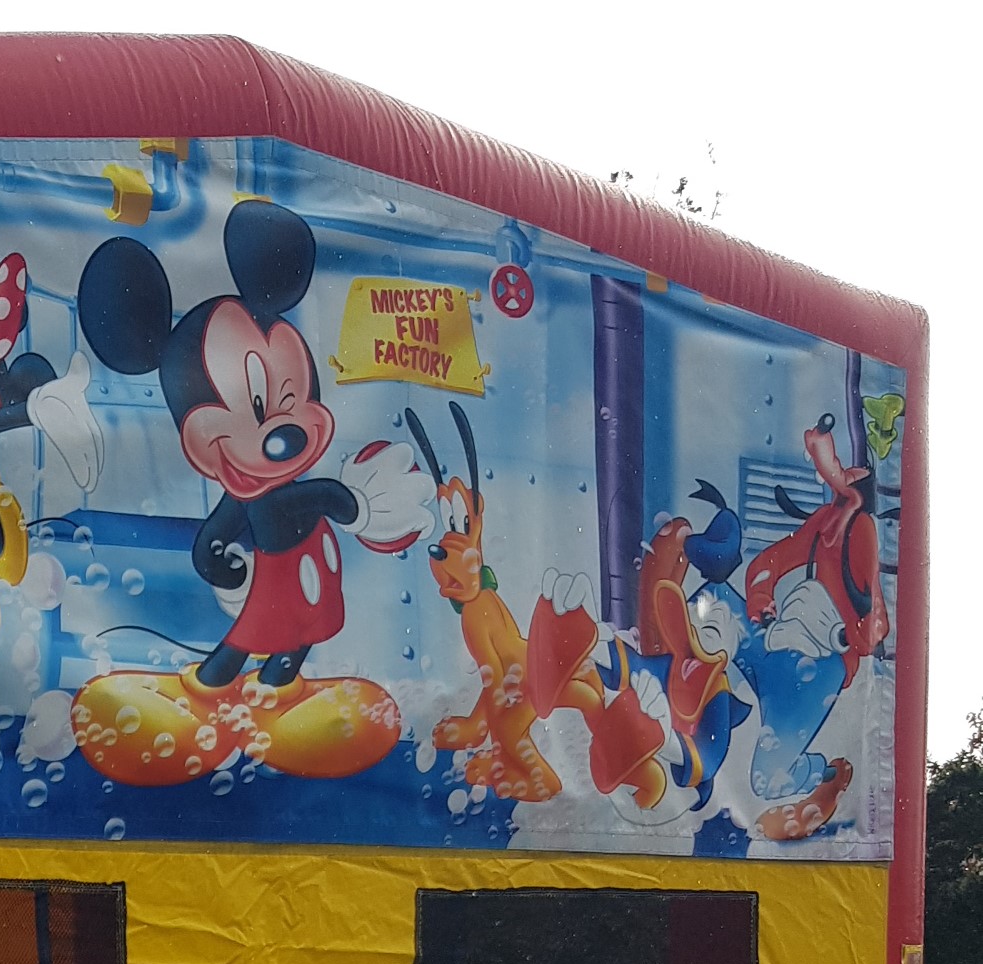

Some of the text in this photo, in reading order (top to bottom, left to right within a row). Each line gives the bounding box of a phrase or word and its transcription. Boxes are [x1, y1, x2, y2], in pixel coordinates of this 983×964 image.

[370, 288, 455, 314] MICKEY'S
[395, 315, 439, 345] FUN
[374, 338, 453, 381] FACTORY
